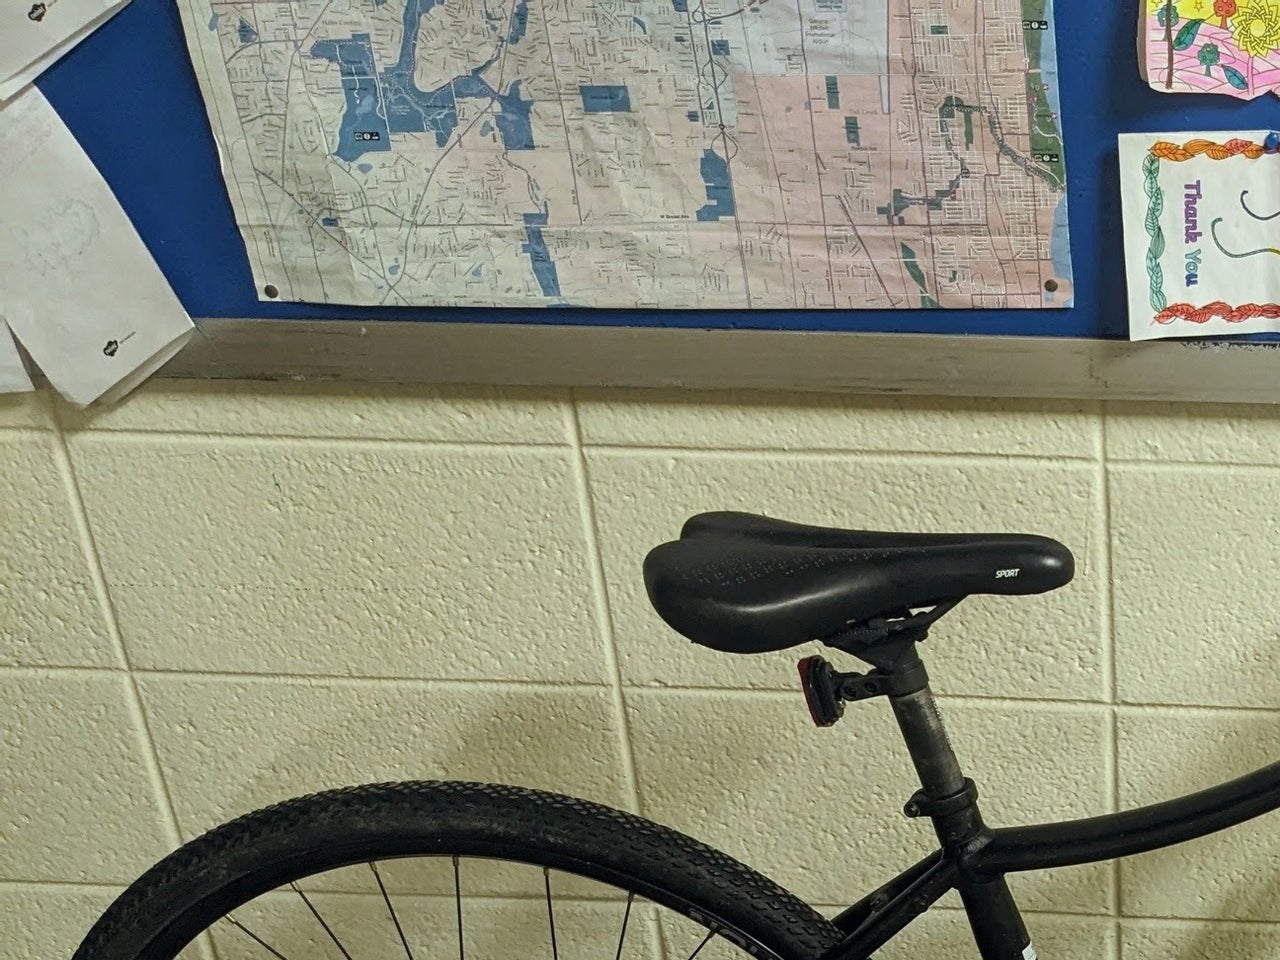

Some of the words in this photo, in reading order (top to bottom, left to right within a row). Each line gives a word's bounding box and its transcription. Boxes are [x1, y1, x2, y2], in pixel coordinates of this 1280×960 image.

[1184, 180, 1202, 244] Thank
[1185, 248, 1202, 287] You
[995, 568, 1020, 578] SPORT
